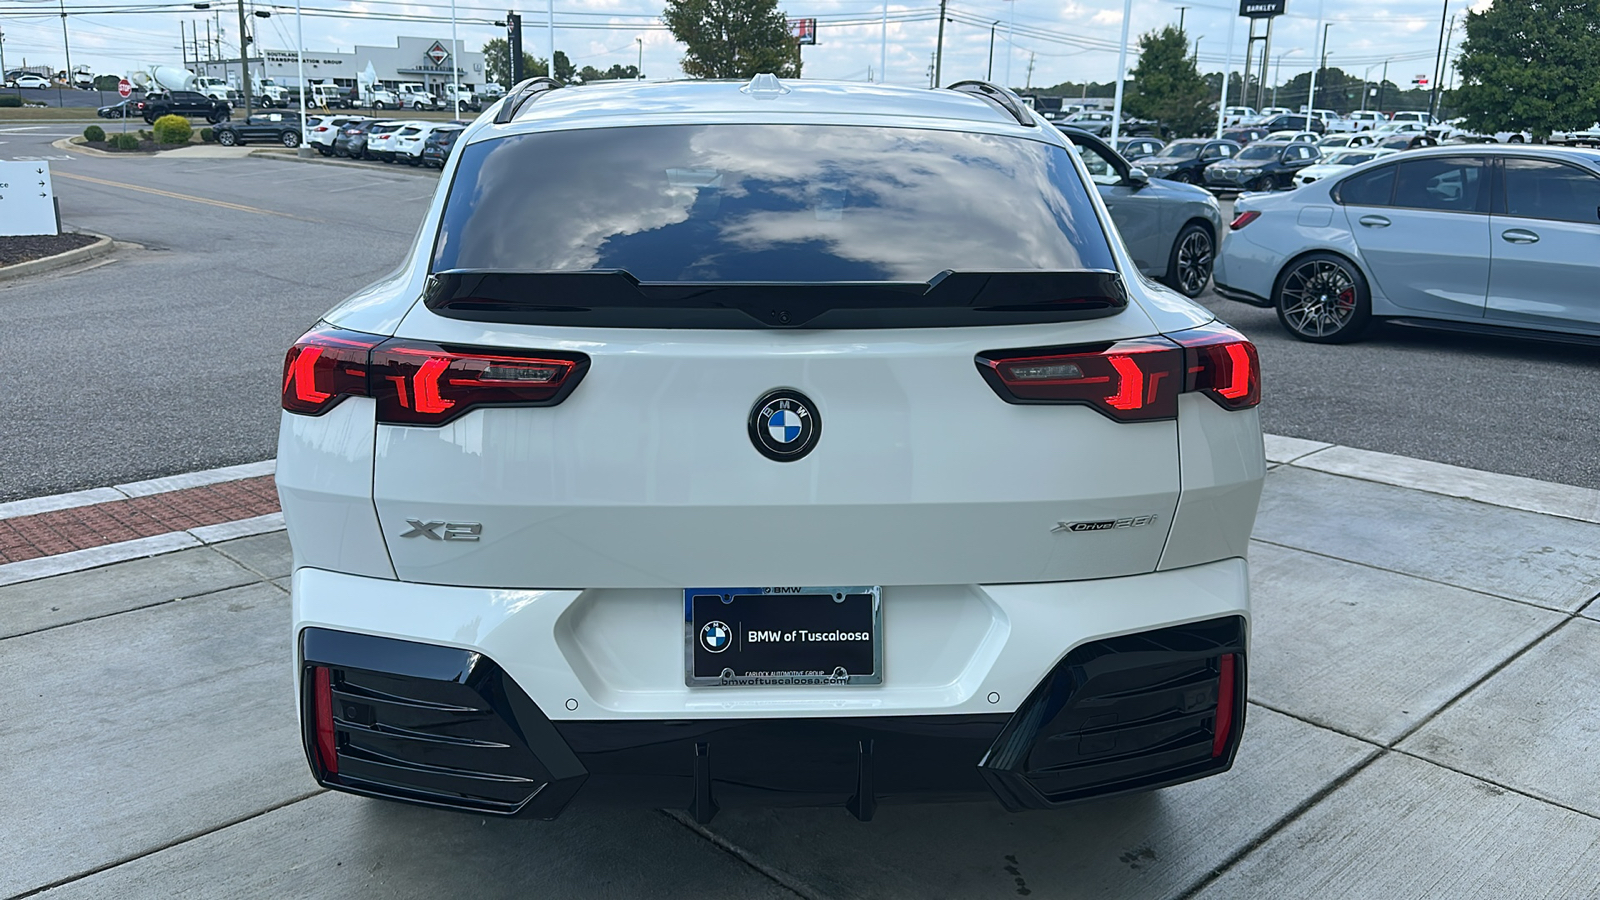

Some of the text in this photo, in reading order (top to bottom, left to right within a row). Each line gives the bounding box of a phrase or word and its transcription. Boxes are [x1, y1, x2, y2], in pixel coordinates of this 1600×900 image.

[1246, 3, 1277, 12] BARKLEY
[119, 84, 131, 92] STOP
[763, 400, 807, 418] BMW
[400, 518, 482, 541] X2
[704, 622, 728, 632] BMW
[748, 630, 870, 642] BMW of Tuscaloosa
[721, 677, 847, 686] bmwoftuscaloosa.com
